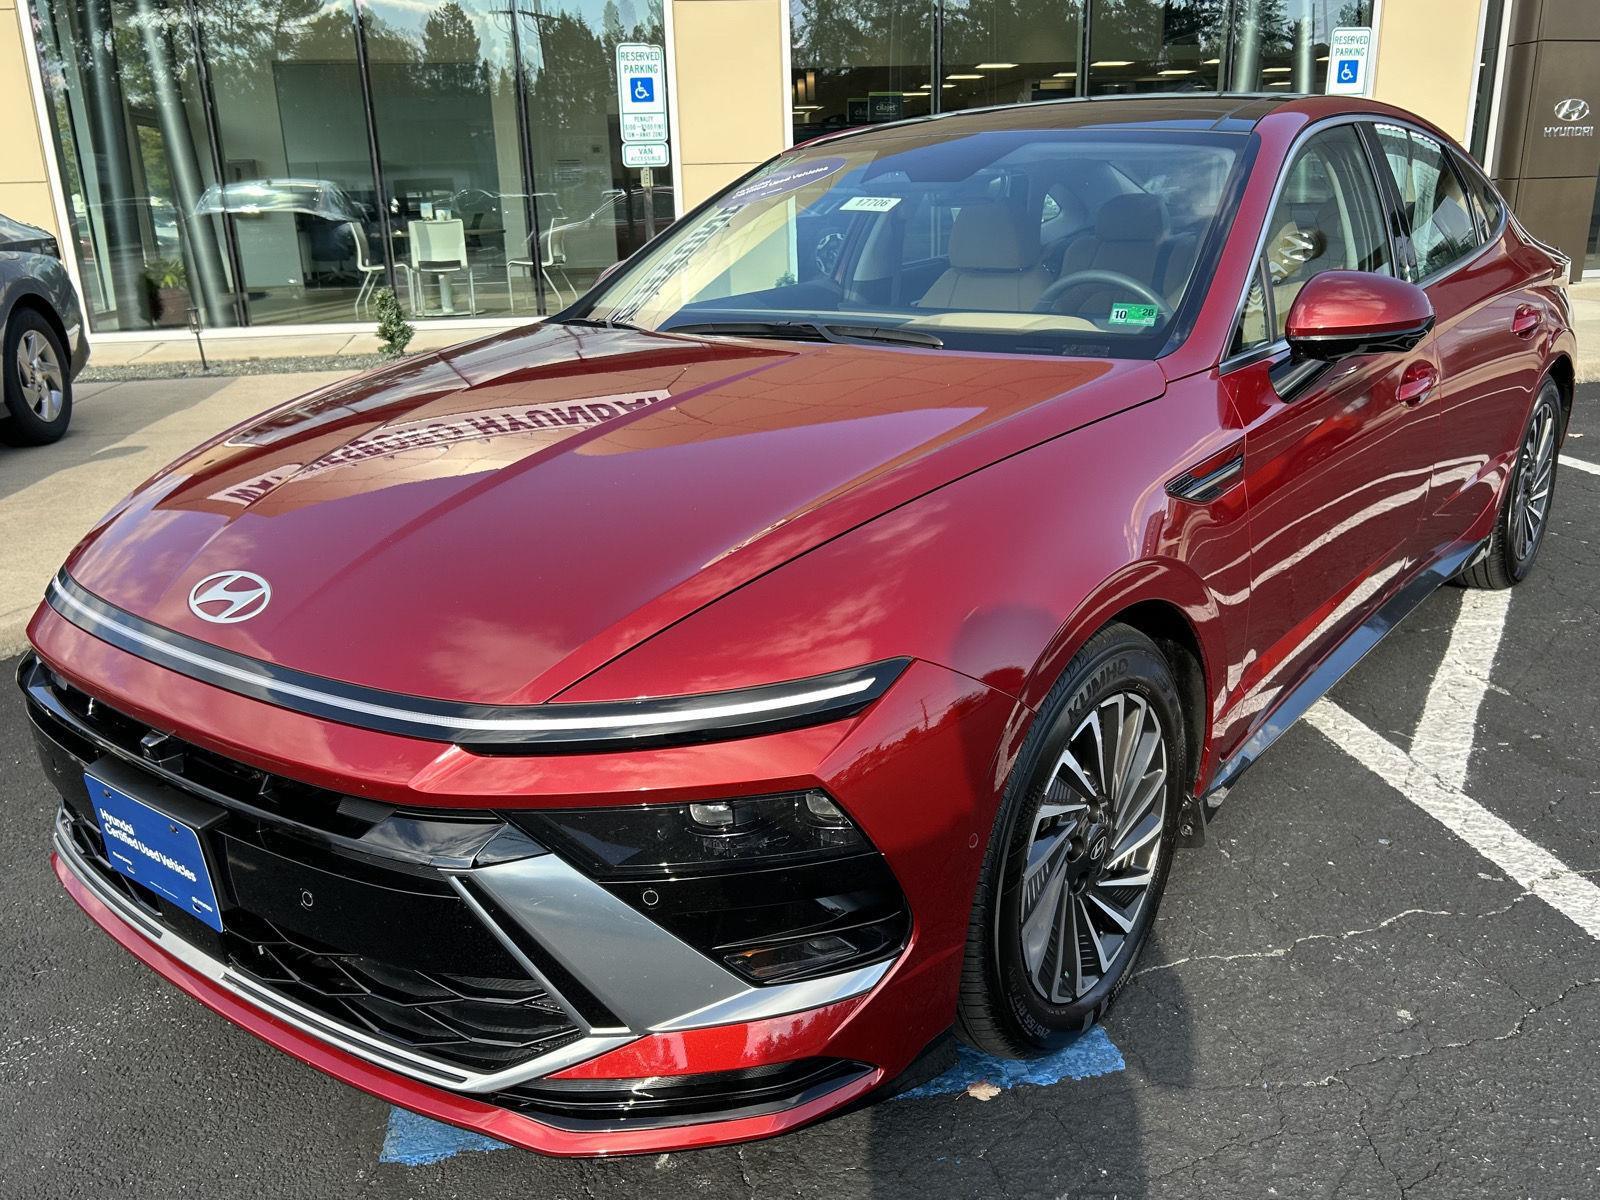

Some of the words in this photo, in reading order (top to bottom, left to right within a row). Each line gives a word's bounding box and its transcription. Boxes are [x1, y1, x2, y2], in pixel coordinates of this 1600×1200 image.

[1334, 35, 1368, 45] RESERVED
[620, 51, 660, 61] RESERVED
[1335, 47, 1365, 57] PARKING
[623, 64, 658, 74] PARKING
[1543, 126, 1594, 138] HYUNDAI
[855, 198, 891, 207] 17706
[1114, 310, 1127, 320] 10
[1068, 658, 1129, 723] KUMHO
[99, 807, 135, 836] Hyundai
[104, 823, 140, 851] Certified
[138, 841, 161, 864] Used
[160, 854, 197, 882] Vehicles
